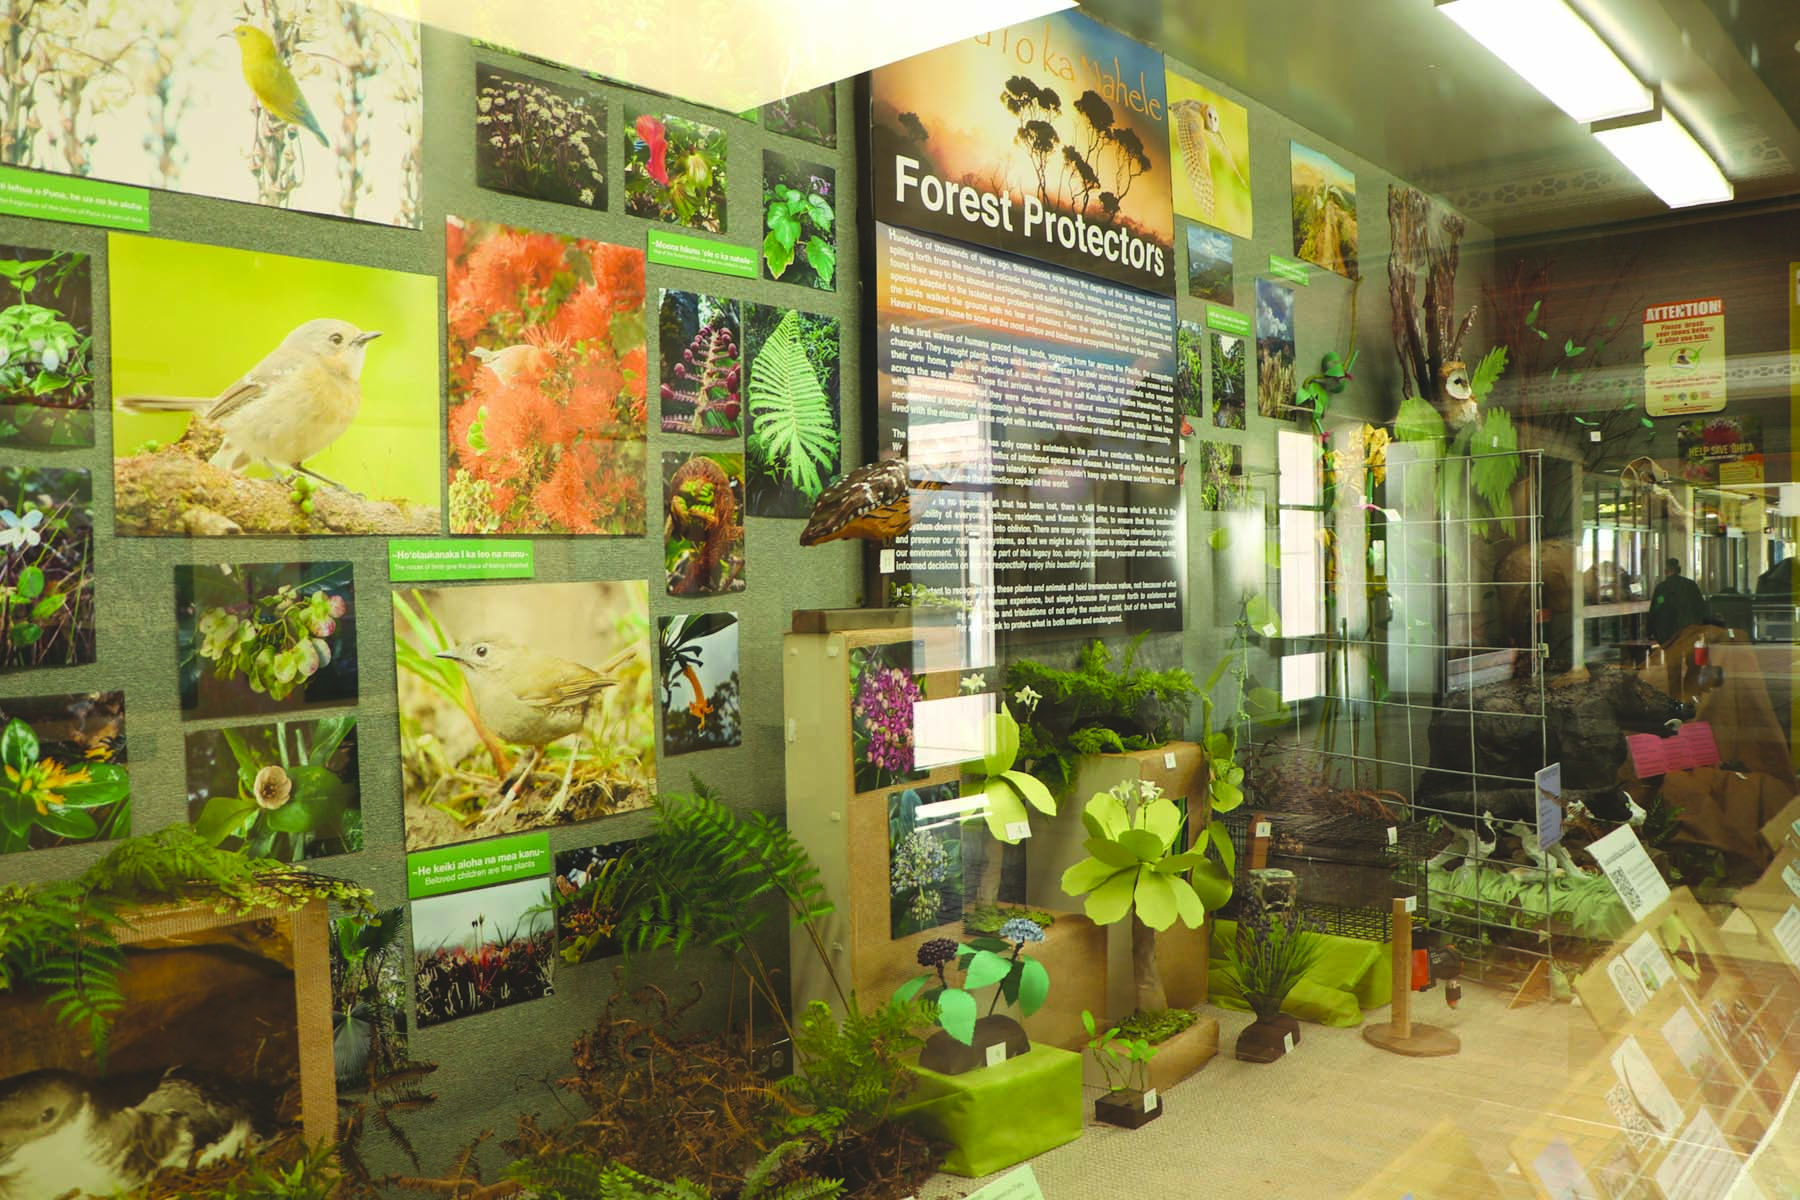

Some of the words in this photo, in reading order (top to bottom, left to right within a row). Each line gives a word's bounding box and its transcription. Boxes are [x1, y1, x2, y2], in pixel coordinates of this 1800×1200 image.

[895, 155, 1014, 232] Forest
[1024, 194, 1165, 277] Protectors
[888, 228, 922, 247] Hundreds
[934, 242, 968, 259] thousands
[979, 256, 996, 266] years
[952, 259, 961, 270] the
[928, 268, 942, 280] way
[890, 283, 902, 294] the
[951, 296, 962, 306] the
[956, 285, 966, 295] the
[902, 324, 913, 335] the
[916, 326, 931, 338] first
[933, 332, 954, 342] waves
[964, 336, 988, 348] humans
[990, 342, 1011, 352] graced
[1012, 345, 1028, 355] these
[890, 336, 923, 350] changed.
[925, 341, 941, 355] They
[943, 345, 967, 358] brought
[890, 348, 907, 360] their
[910, 354, 924, 362] new
[927, 354, 948, 368] home,
[950, 360, 962, 368] and
[890, 364, 914, 374] across
[916, 366, 928, 376] the
[931, 370, 946, 379] seas
[977, 375, 995, 386] These
[997, 378, 1008, 388] first
[989, 389, 1002, 401] they
[1021, 394, 1051, 406] dependent
[892, 427, 905, 438] The
[1000, 439, 1013, 450] only
[1018, 452, 1048, 463] introduced
[1689, 446, 1710, 457] HELP
[1006, 464, 1027, 473] islands
[1028, 466, 1036, 474] for
[1014, 477, 1033, 487] capital
[1041, 478, 1050, 487] the
[1002, 499, 1013, 507] that
[1016, 500, 1026, 508] has
[1029, 500, 1044, 509] been
[1046, 501, 1058, 512] lost,
[1061, 502, 1074, 510] there
[910, 537, 940, 546] preserve
[1049, 538, 1064, 547] might
[998, 549, 1010, 559] part
[1032, 549, 1050, 559] legacy
[896, 561, 926, 570] informed
[928, 561, 958, 569] decisions
[1028, 561, 1044, 570] enjoy
[997, 584, 1012, 593] these
[1014, 584, 1032, 594] plants
[1009, 595, 1042, 606] experience,
[1056, 594, 1073, 603] simply
[1066, 606, 1077, 615] only
[1011, 619, 1030, 630] protect
[1032, 618, 1045, 627] what
[1052, 617, 1064, 626] both
[433, 861, 455, 874] keiki
[457, 857, 483, 869] aloha
[498, 852, 517, 863] mea
[424, 873, 456, 886] Beloved
[457, 868, 487, 881] children
[488, 867, 500, 875] are
[501, 863, 513, 872] the
[514, 860, 536, 873] plants
